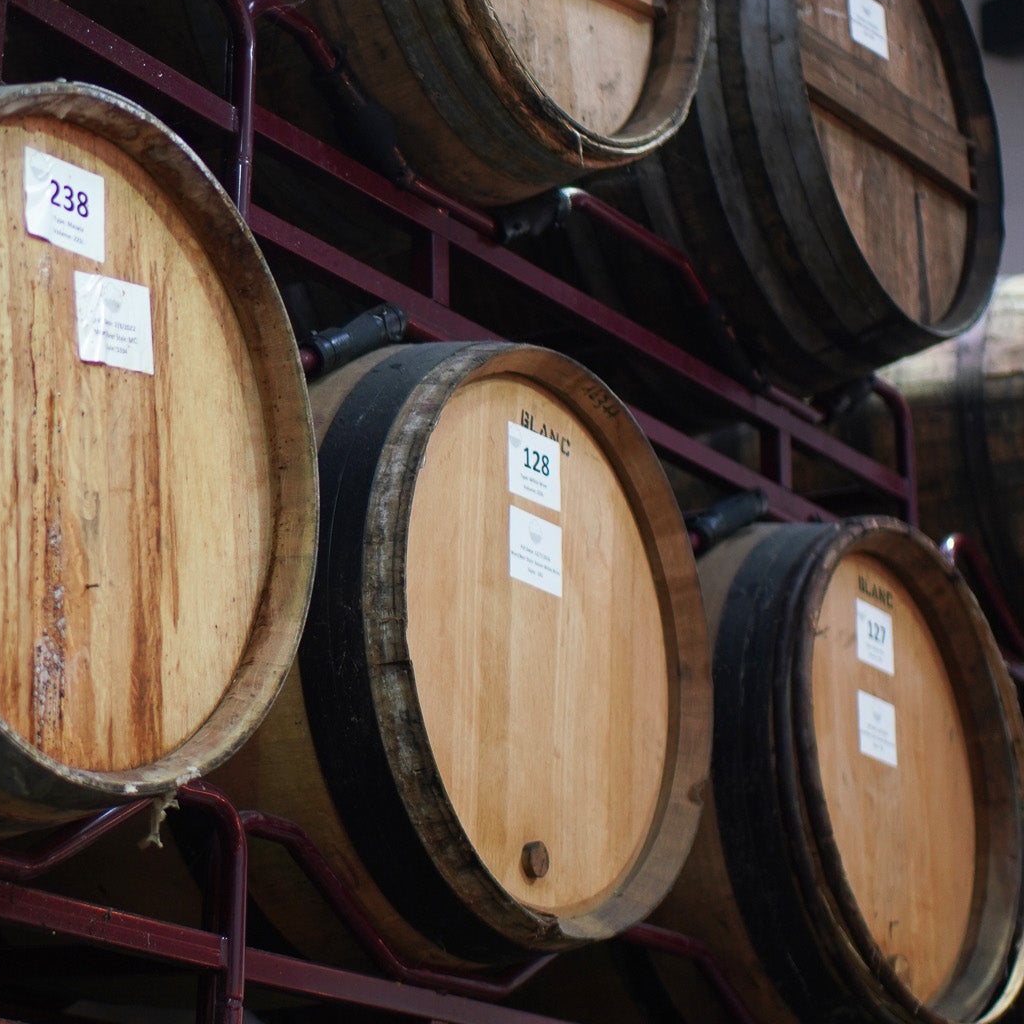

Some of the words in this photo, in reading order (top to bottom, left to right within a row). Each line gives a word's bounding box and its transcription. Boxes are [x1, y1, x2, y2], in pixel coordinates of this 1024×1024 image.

[50, 179, 89, 218] 238
[523, 447, 550, 476] 128
[858, 575, 893, 609] BLANC
[867, 620, 886, 644] 127
